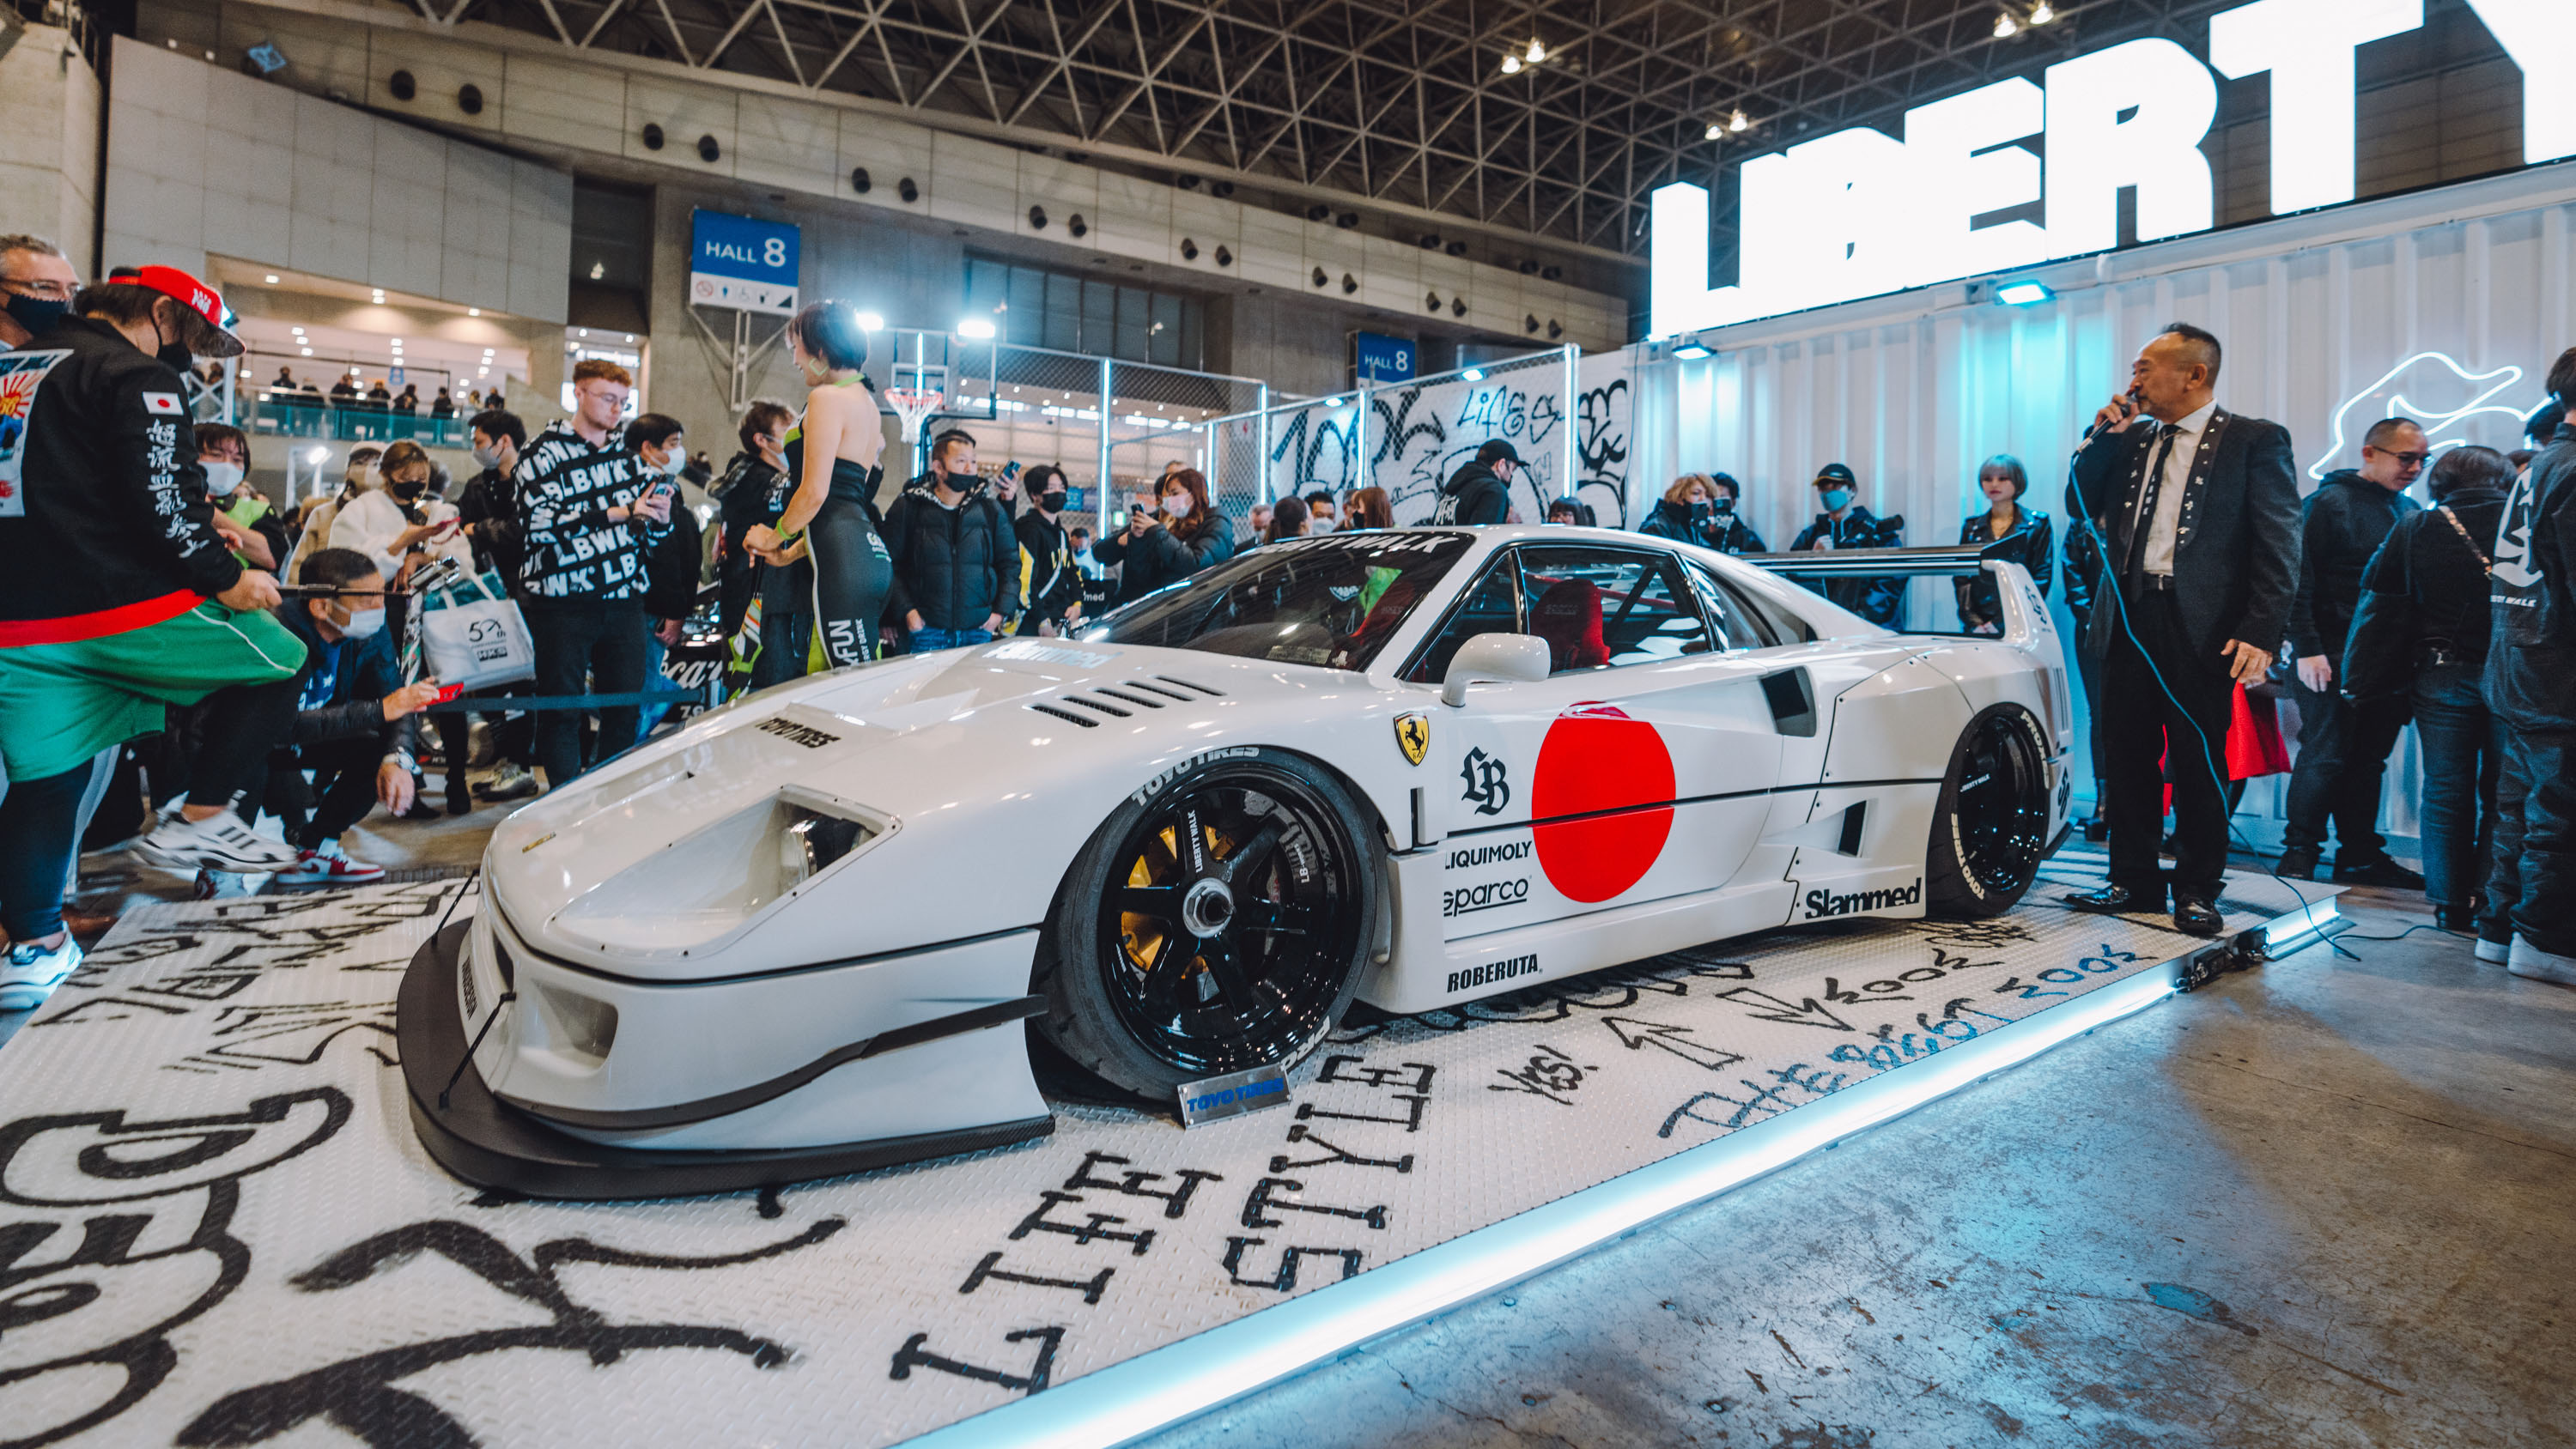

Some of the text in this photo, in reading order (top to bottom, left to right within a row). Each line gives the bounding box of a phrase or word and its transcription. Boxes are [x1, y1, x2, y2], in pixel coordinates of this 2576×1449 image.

[705, 238, 786, 268] HALL 8
[1364, 350, 1408, 372] HALL 8
[1132, 746, 1260, 807] TOYO TIRES
[1805, 877, 1922, 919] Slammed
[1961, 864, 1985, 900] TOYO
[1447, 954, 1539, 992] ROBERUTA
[1187, 1077, 1285, 1113] TOYO TIRES
[1222, 1055, 1437, 1292] STYLE
[890, 1150, 1222, 1396] LIFE
